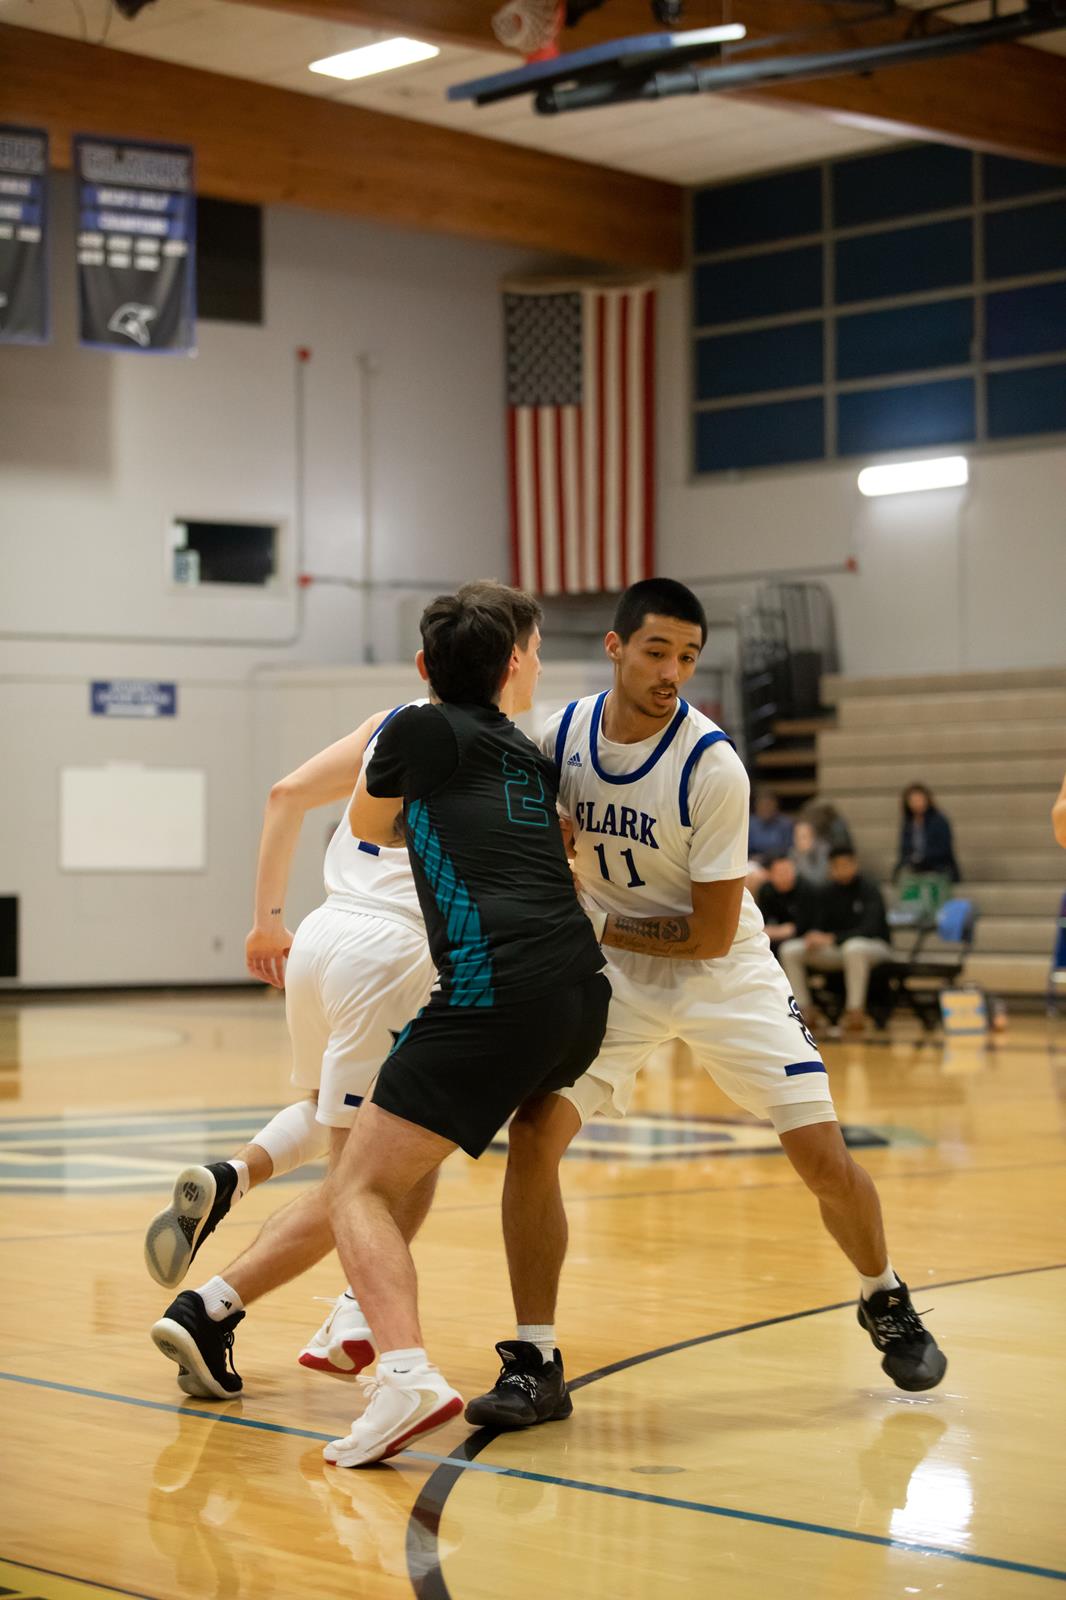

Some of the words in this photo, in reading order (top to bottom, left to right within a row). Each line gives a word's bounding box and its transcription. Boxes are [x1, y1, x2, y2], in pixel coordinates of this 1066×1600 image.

[503, 752, 549, 827] 2
[576, 801, 660, 849] CLARK
[594, 843, 646, 888] 11
